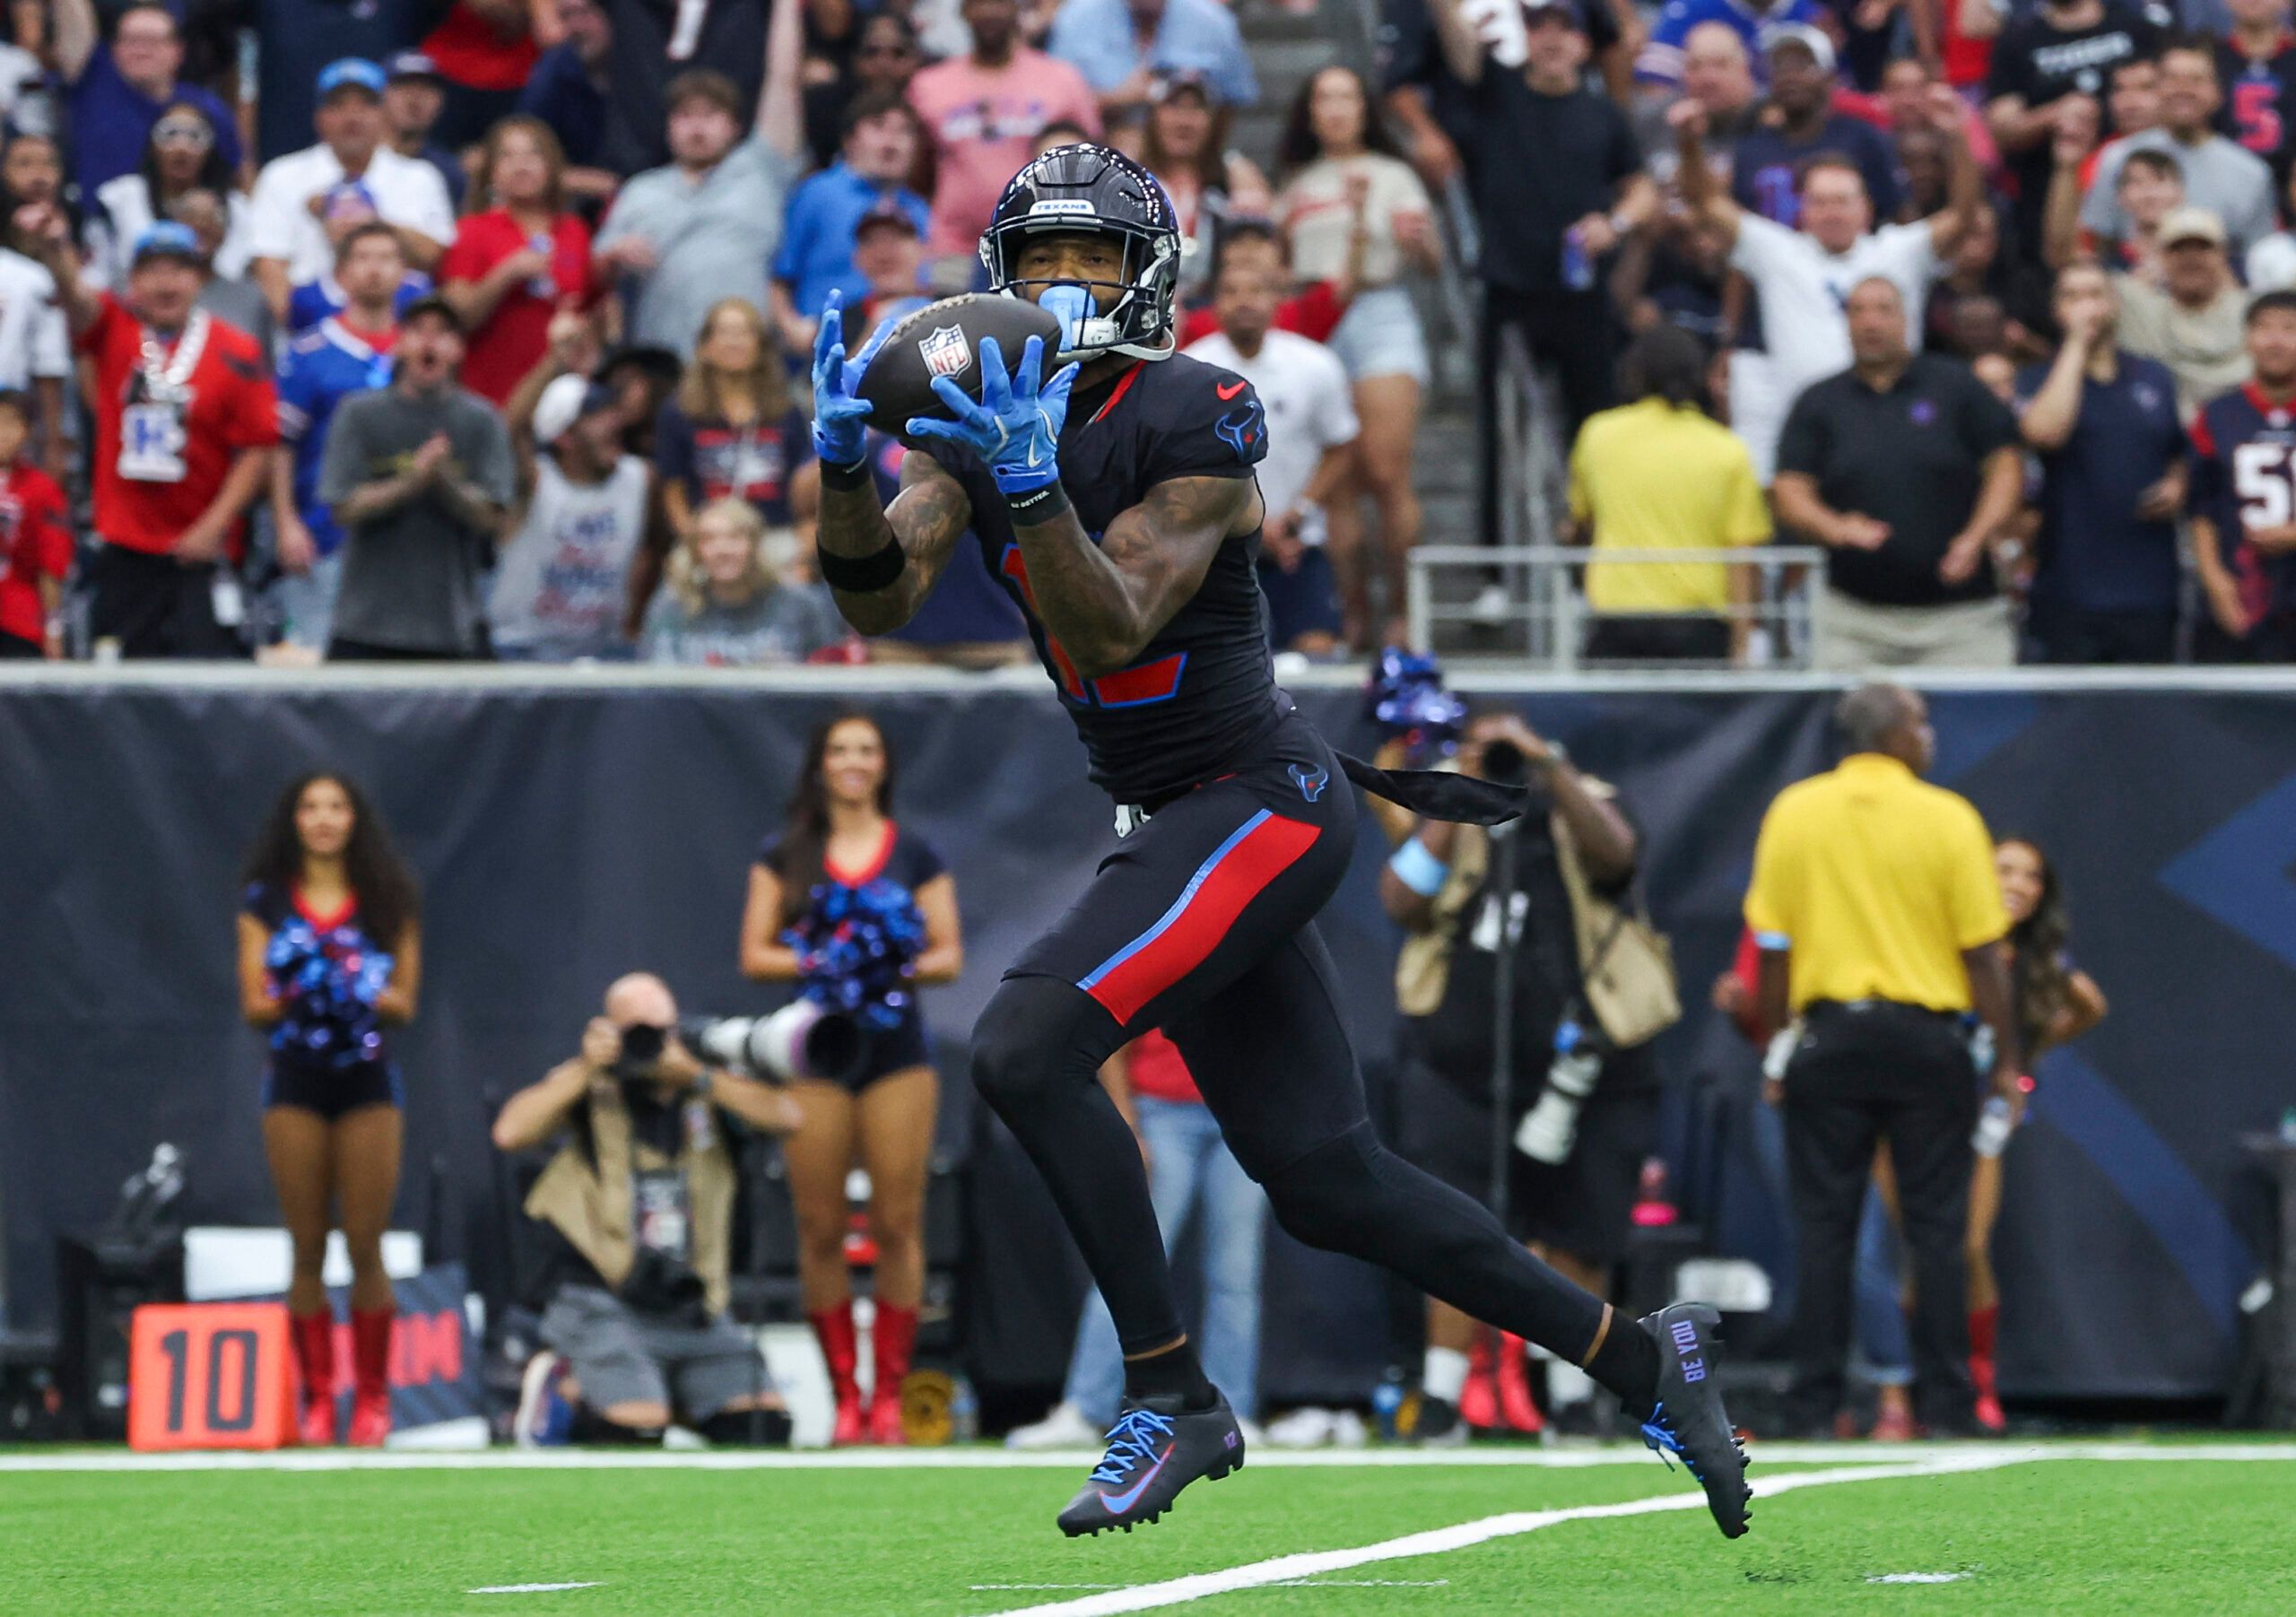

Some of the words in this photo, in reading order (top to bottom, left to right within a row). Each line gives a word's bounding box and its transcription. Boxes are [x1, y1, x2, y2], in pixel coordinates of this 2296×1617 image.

[931, 345, 967, 375] NFL
[2231, 442, 2296, 531] 5
[1671, 1320, 1698, 1355] YOU
[161, 1329, 258, 1432] 10
[1682, 1358, 1706, 1382] BE
[1223, 1430, 1238, 1449] 12
